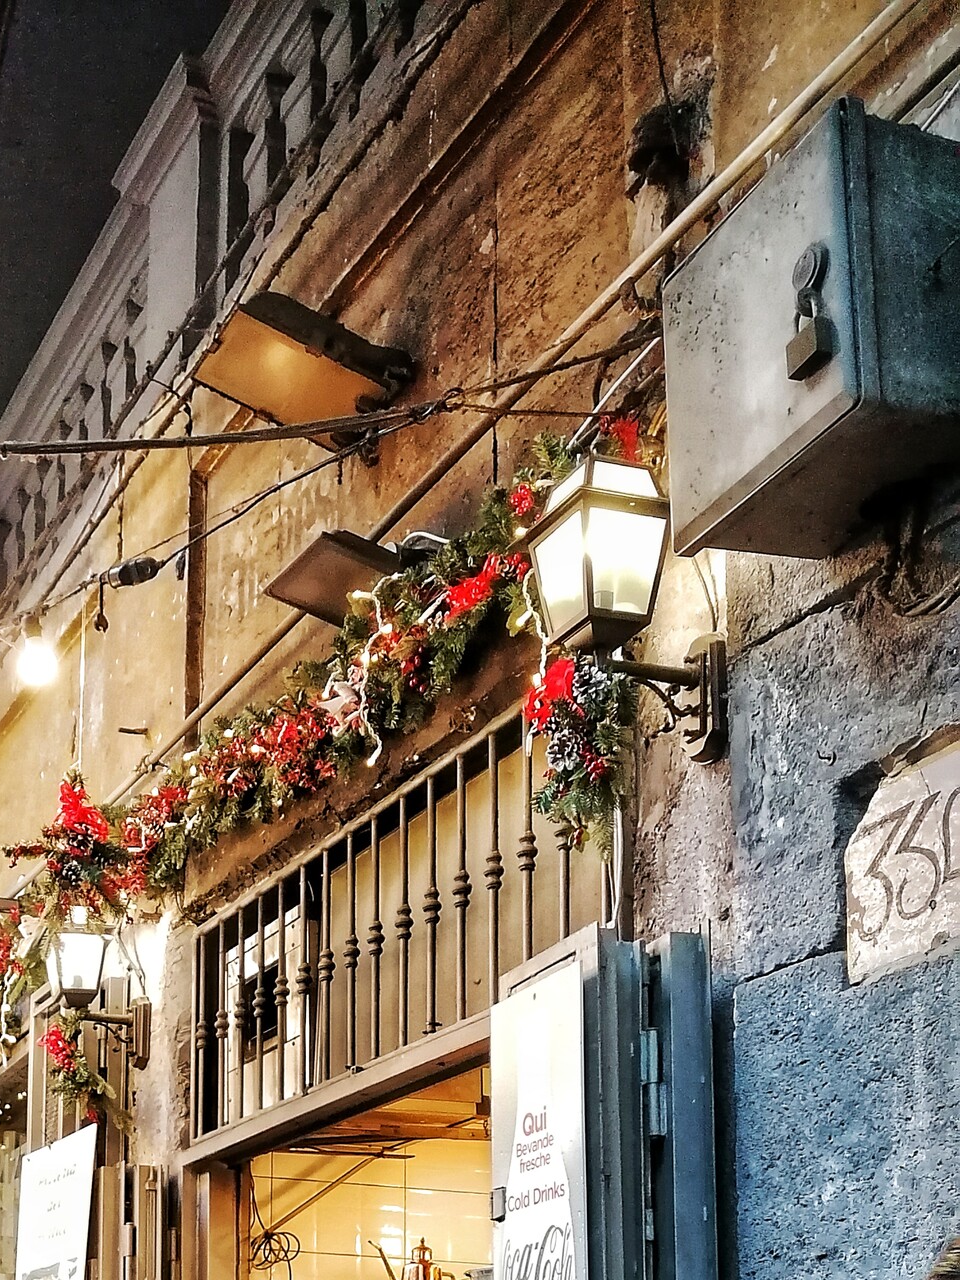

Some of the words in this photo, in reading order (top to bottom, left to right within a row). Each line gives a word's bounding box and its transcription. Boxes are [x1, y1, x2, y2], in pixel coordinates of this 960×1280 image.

[522, 1105, 547, 1136] Qui
[516, 1132, 555, 1158] Bevande
[520, 1152, 551, 1174] fresche
[507, 1189, 530, 1212] Cold
[533, 1181, 566, 1205] Drinks
